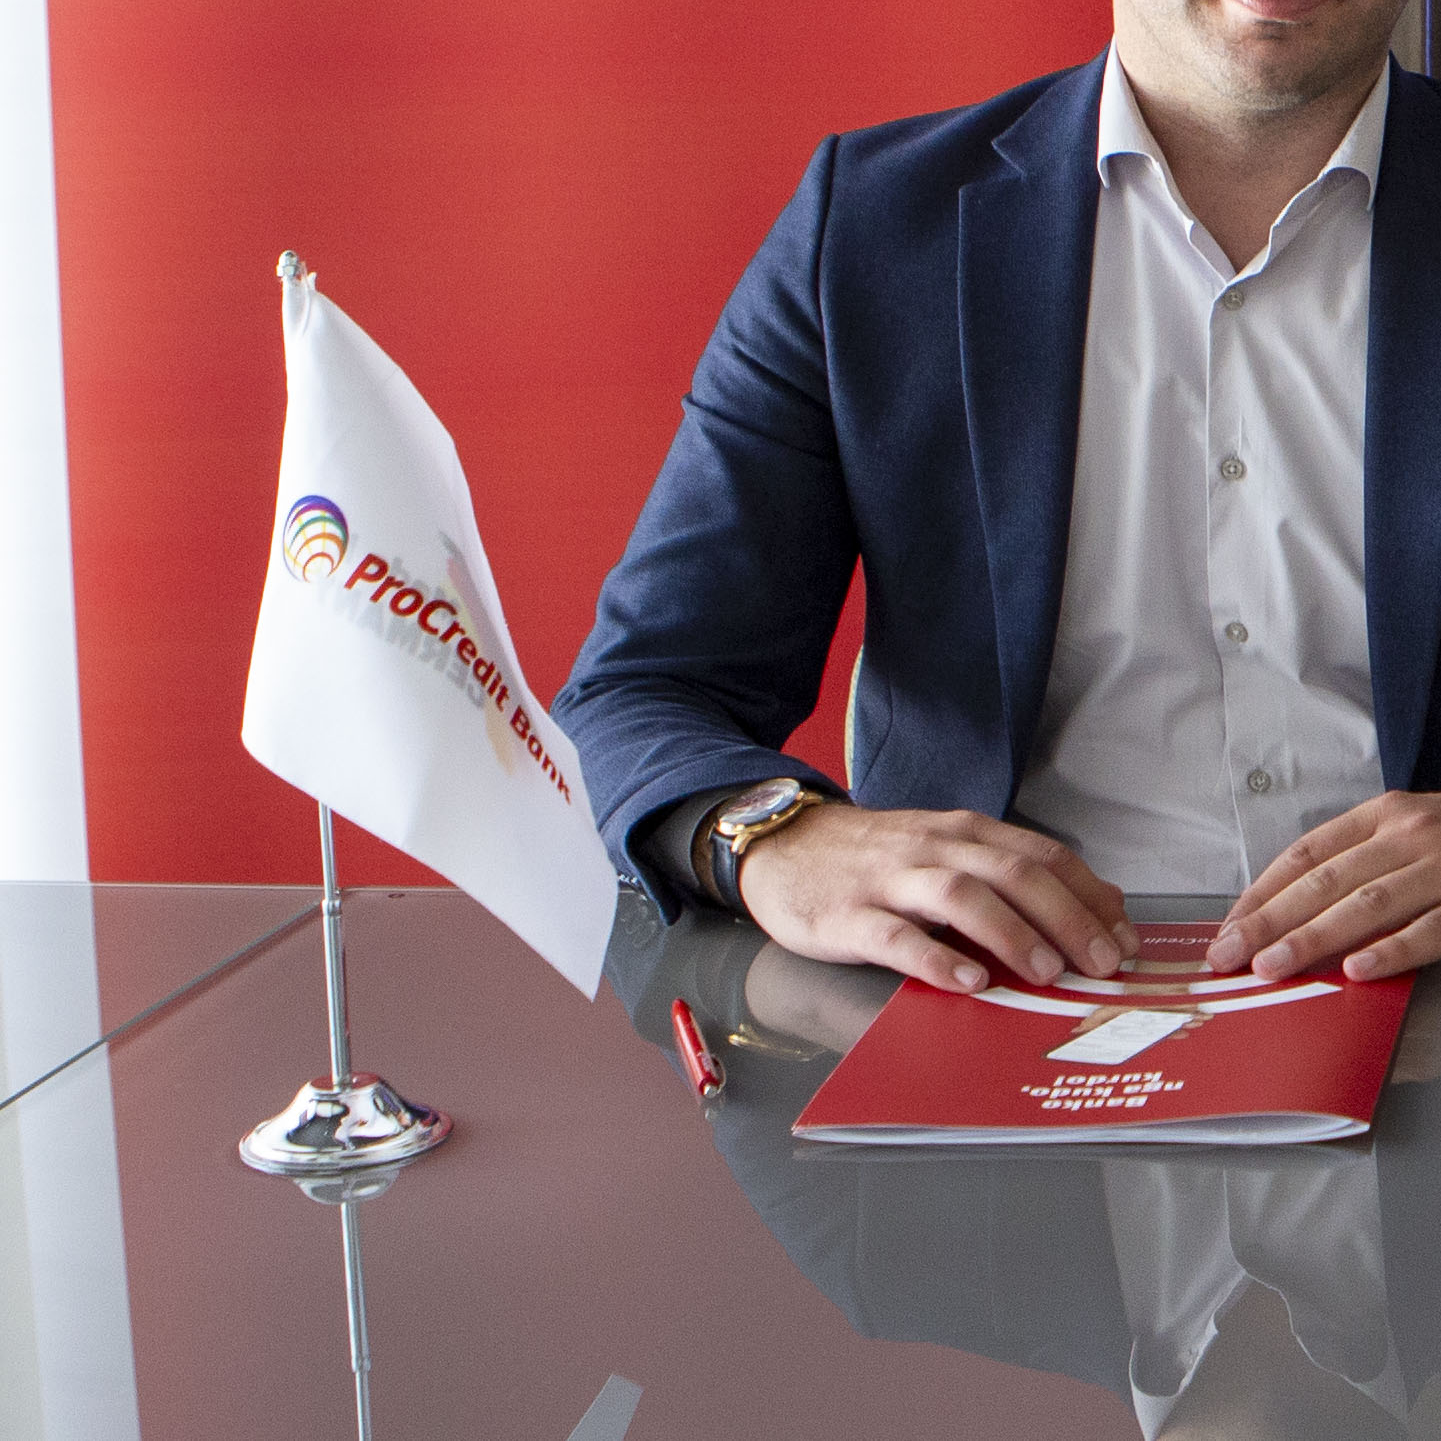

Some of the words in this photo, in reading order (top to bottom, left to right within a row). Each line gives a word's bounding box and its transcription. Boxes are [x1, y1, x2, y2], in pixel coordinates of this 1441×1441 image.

[344, 553, 511, 713] ProCredit
[509, 705, 572, 806] Bank
[1142, 936, 1216, 945] roCredit
[1041, 1094, 1149, 1112] Banko
